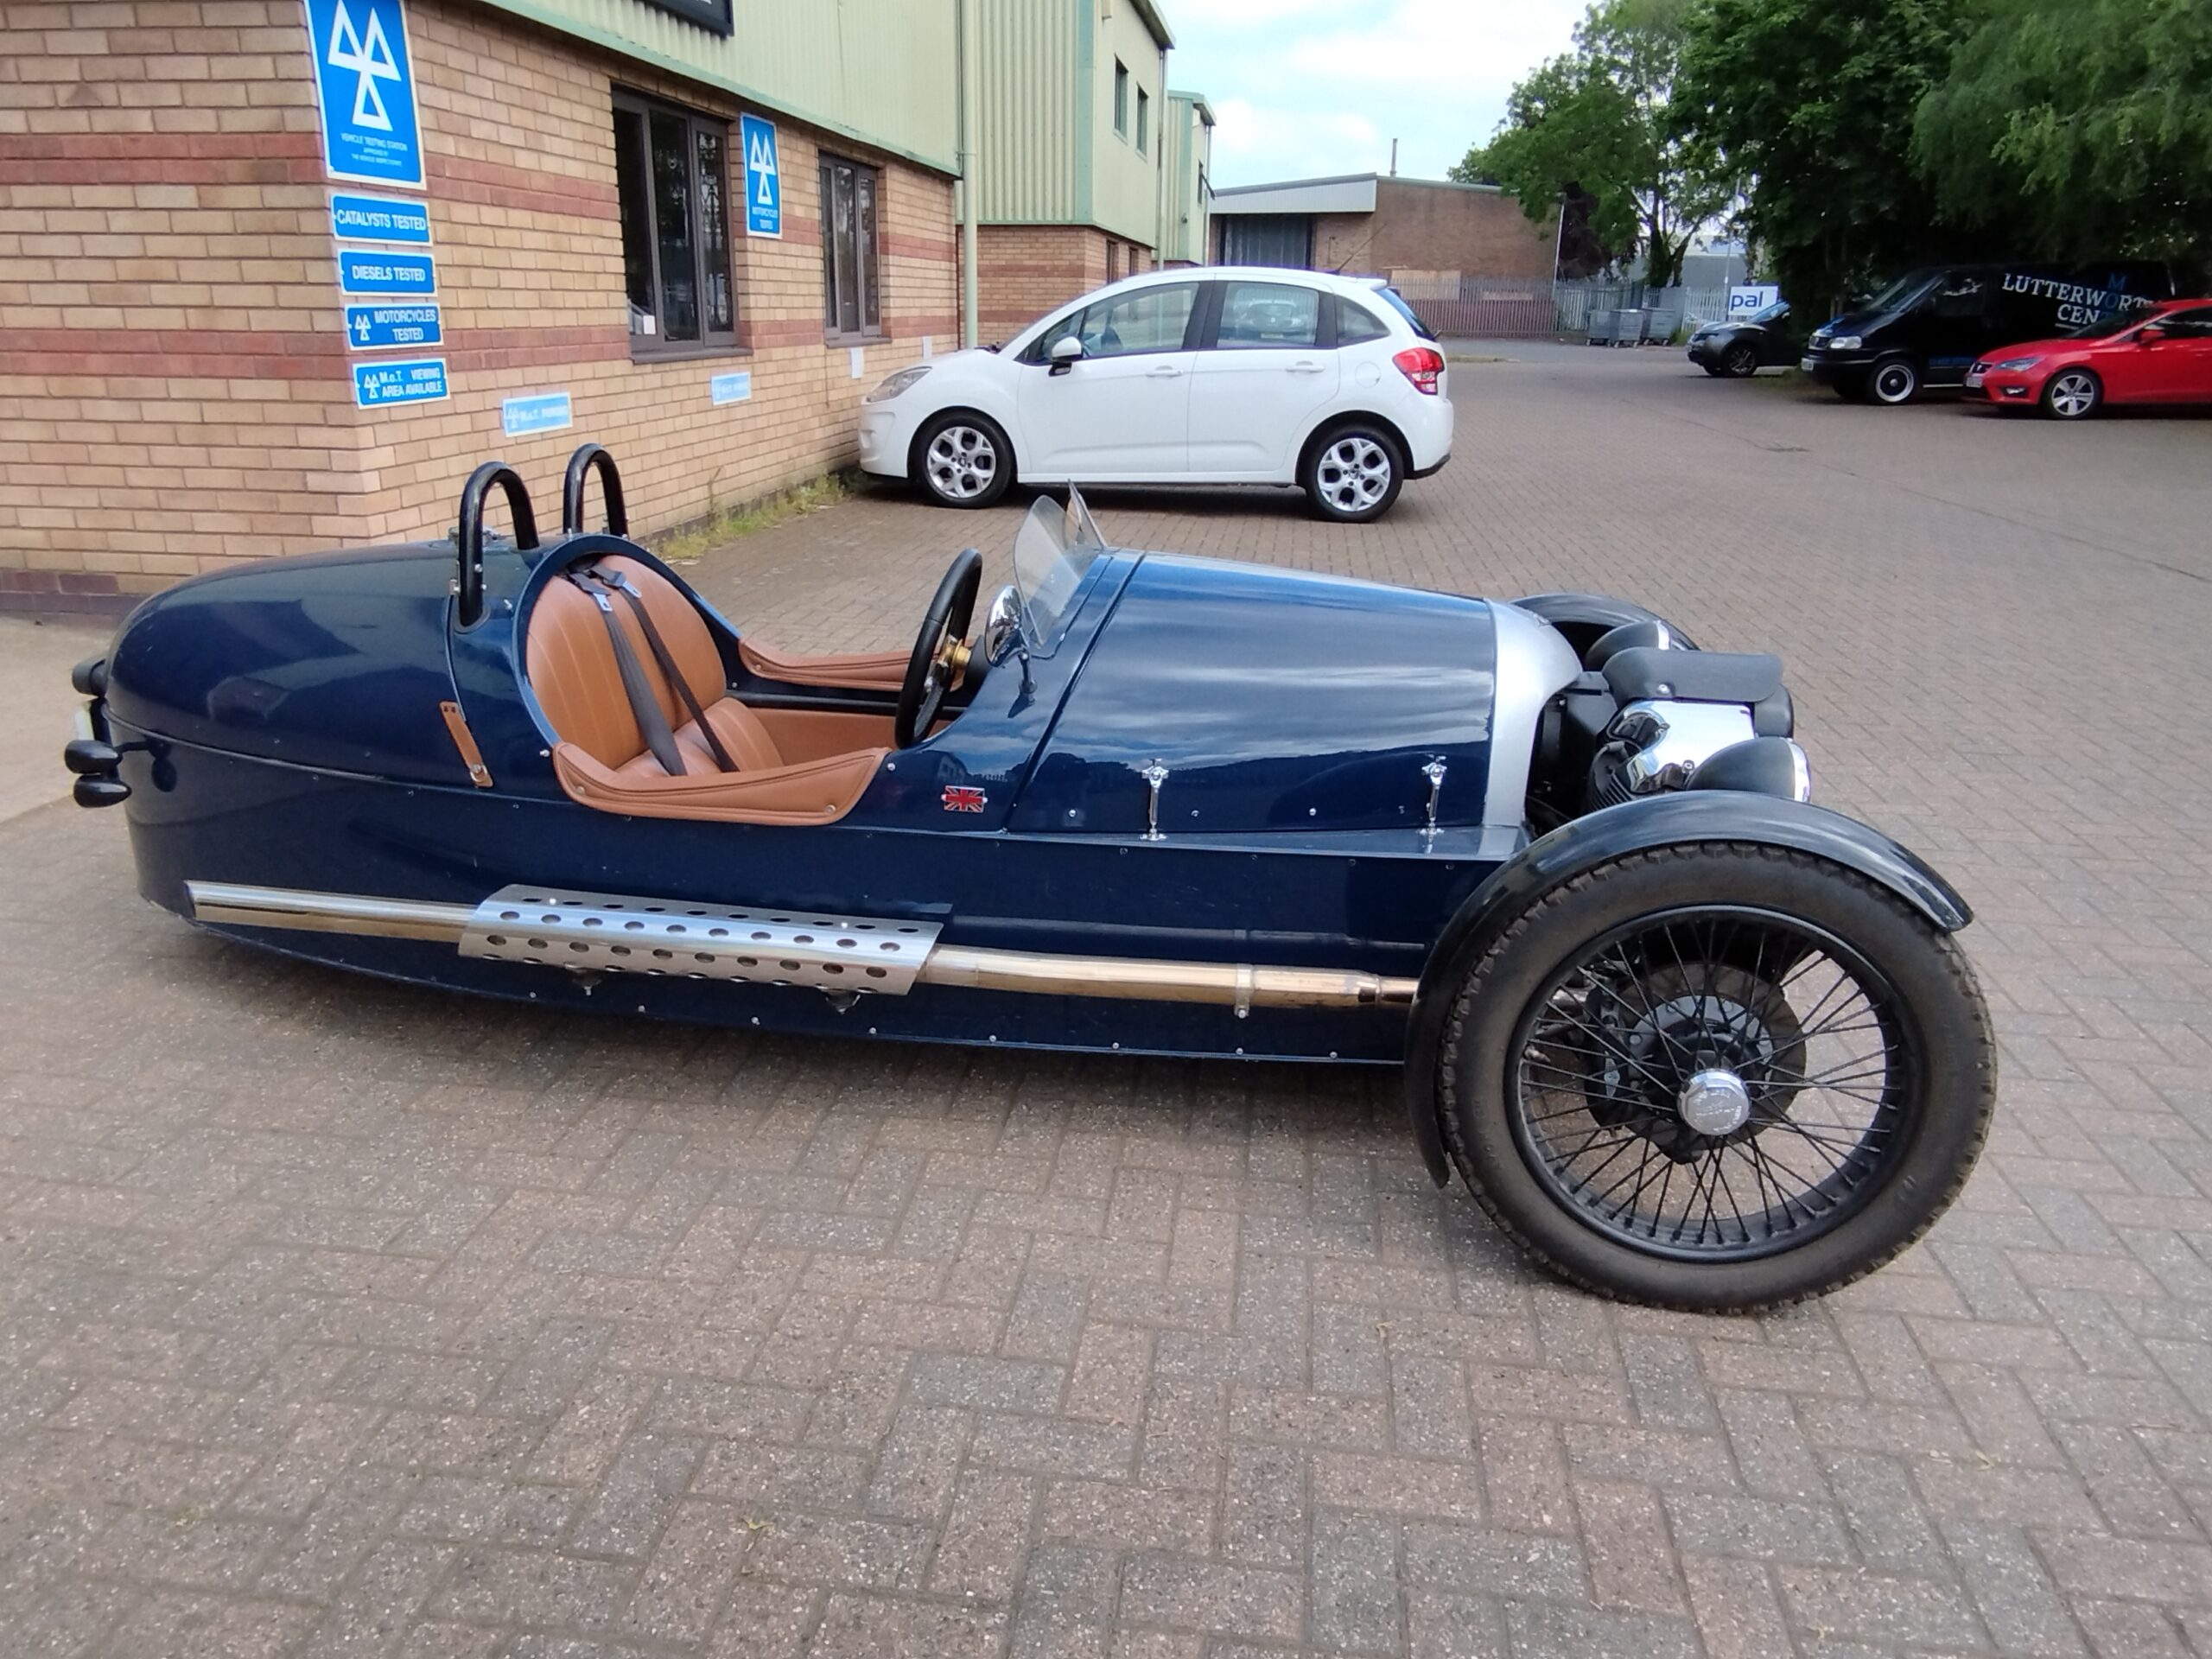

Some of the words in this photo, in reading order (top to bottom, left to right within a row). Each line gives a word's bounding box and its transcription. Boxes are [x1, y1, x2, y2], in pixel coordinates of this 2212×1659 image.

[337, 209, 391, 228] CATALYSTS
[391, 214, 427, 231] TESTED
[352, 265, 393, 281] DIESELS
[393, 267, 426, 282] TESTED
[1730, 290, 1764, 311] pal
[374, 309, 436, 324] MOTORCYCLES
[392, 327, 424, 341] TESTED
[410, 367, 441, 380] VIEWING
[382, 385, 405, 398] AREA
[405, 381, 442, 396] AVAILABLE
